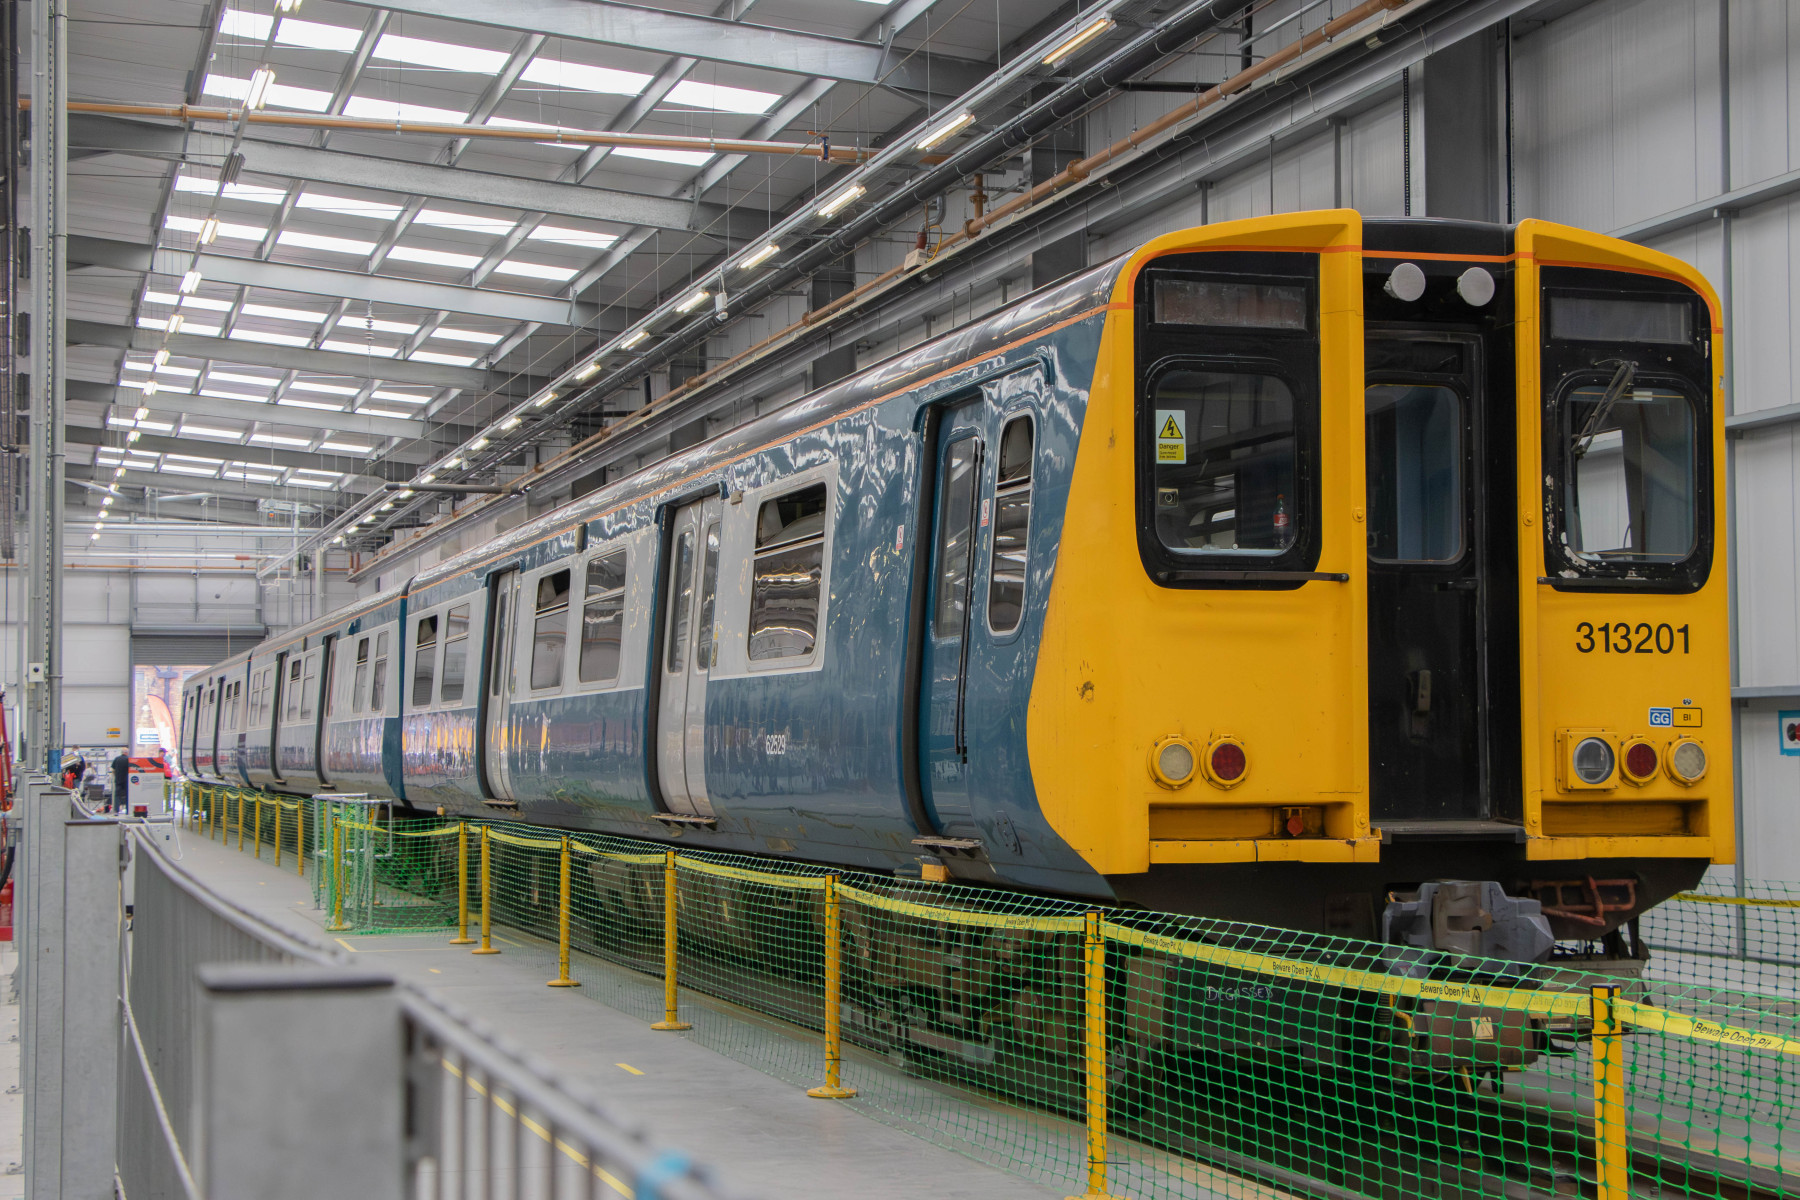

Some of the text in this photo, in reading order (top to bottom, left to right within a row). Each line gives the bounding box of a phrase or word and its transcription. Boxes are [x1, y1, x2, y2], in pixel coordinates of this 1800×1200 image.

[1159, 443, 1179, 451] Danger
[1575, 621, 1690, 654] 313201
[1651, 712, 1670, 724] GG
[766, 734, 785, 755] 62529
[1143, 935, 1159, 947] Beware
[1159, 938, 1170, 949] Open
[1272, 961, 1313, 977] Beware Open Pit
[1420, 982, 1471, 999] Beware Open Pit
[1693, 1022, 1772, 1048] Beware Open Pit
